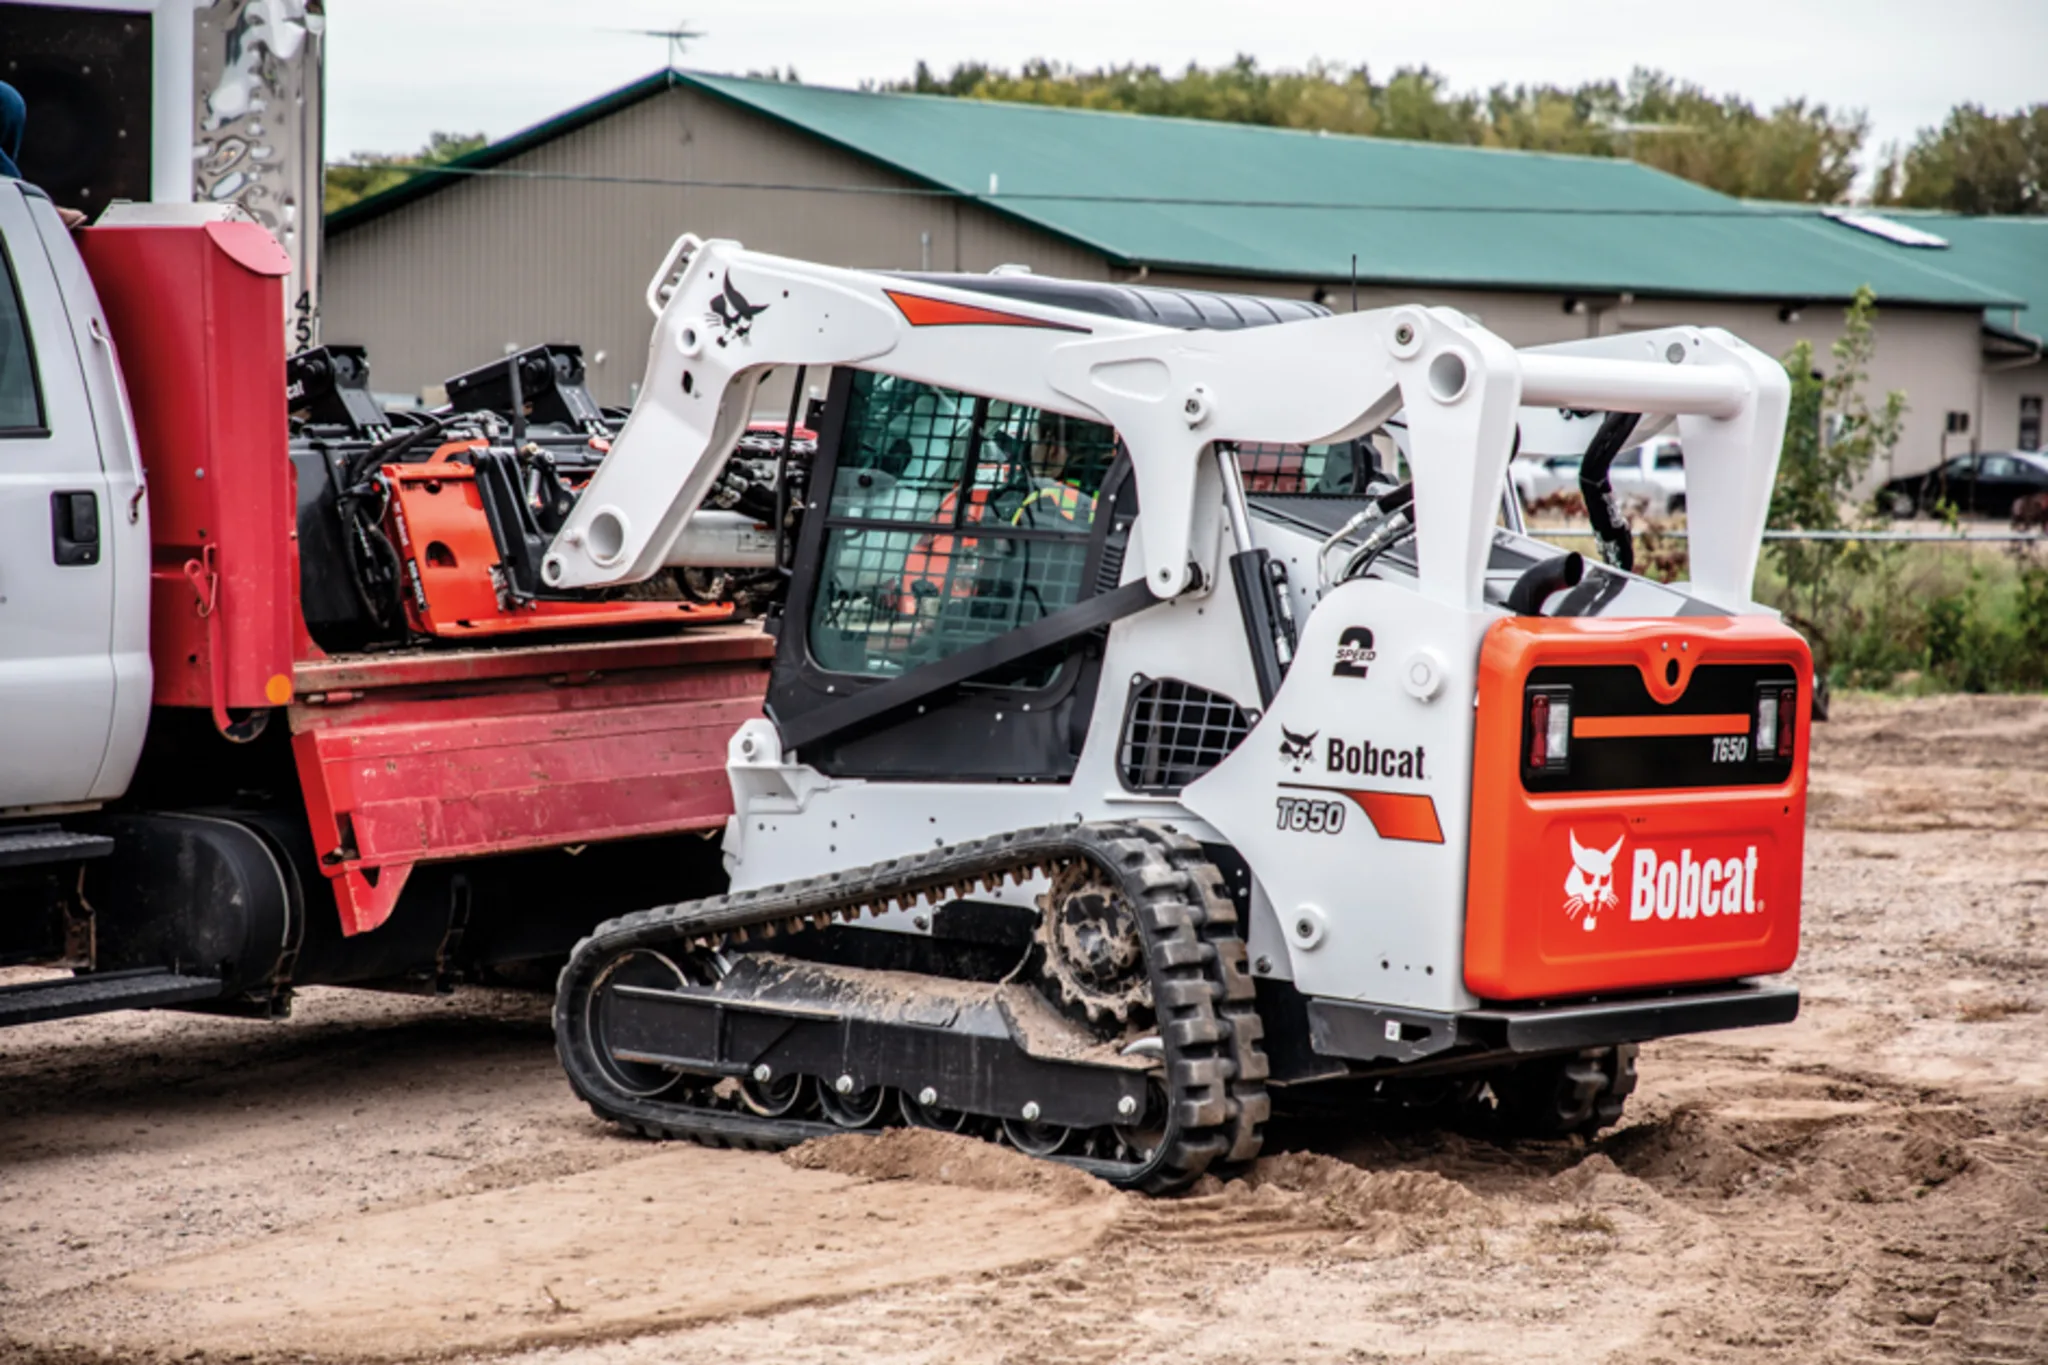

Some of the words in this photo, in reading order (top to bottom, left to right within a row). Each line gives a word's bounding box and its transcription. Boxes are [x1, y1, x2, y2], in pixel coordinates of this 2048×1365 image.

[1332, 626, 1374, 679] 2
[1335, 649, 1377, 661] SPEED
[1327, 737, 1425, 780] Bobcat
[1713, 736, 1748, 763] T650
[1276, 796, 1347, 835] T650
[1629, 846, 1758, 922] Bobcat
